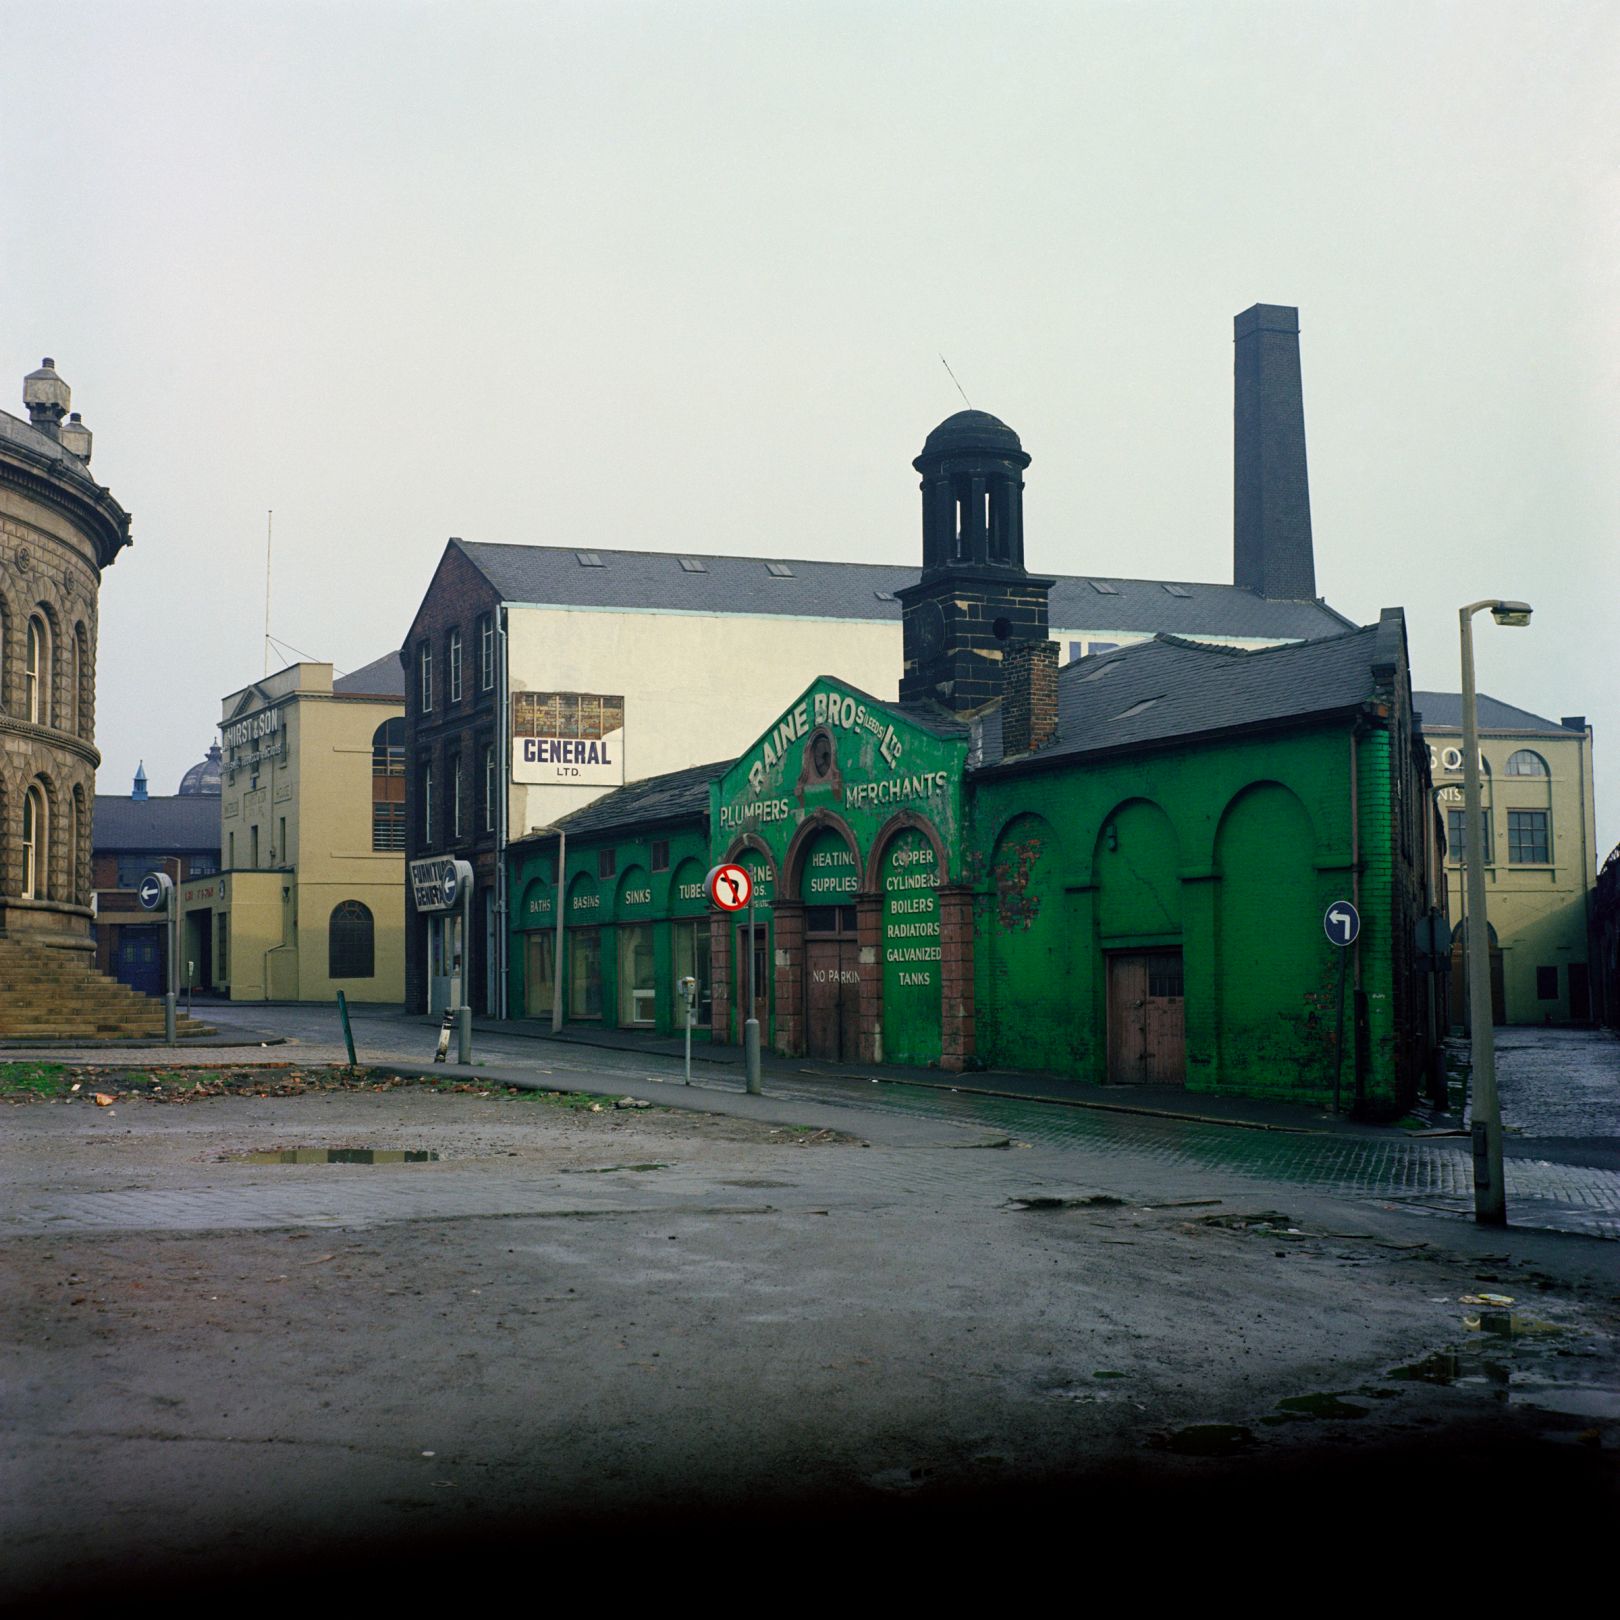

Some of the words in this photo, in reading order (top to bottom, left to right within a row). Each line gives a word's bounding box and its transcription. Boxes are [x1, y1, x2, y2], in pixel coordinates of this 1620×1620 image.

[227, 719, 252, 747] HIRST
[259, 708, 278, 736] SON
[523, 739, 611, 765] GENERAL
[748, 702, 809, 794] RAINE
[556, 767, 582, 777] LTD.
[846, 771, 947, 809] MERCHANTS
[720, 799, 789, 827] PLUMBERS
[811, 877, 858, 892] SUPPLIES
[886, 874, 941, 891] CYLINDERS
[573, 895, 600, 909] BASINS
[625, 889, 651, 905] SINKS
[530, 899, 551, 913] BATHS
[891, 898, 934, 914] BOILERS
[887, 923, 940, 938] RADIATORS
[886, 947, 942, 962] GALVANIZED
[812, 970, 826, 983] NO
[898, 972, 930, 985] TANKS
